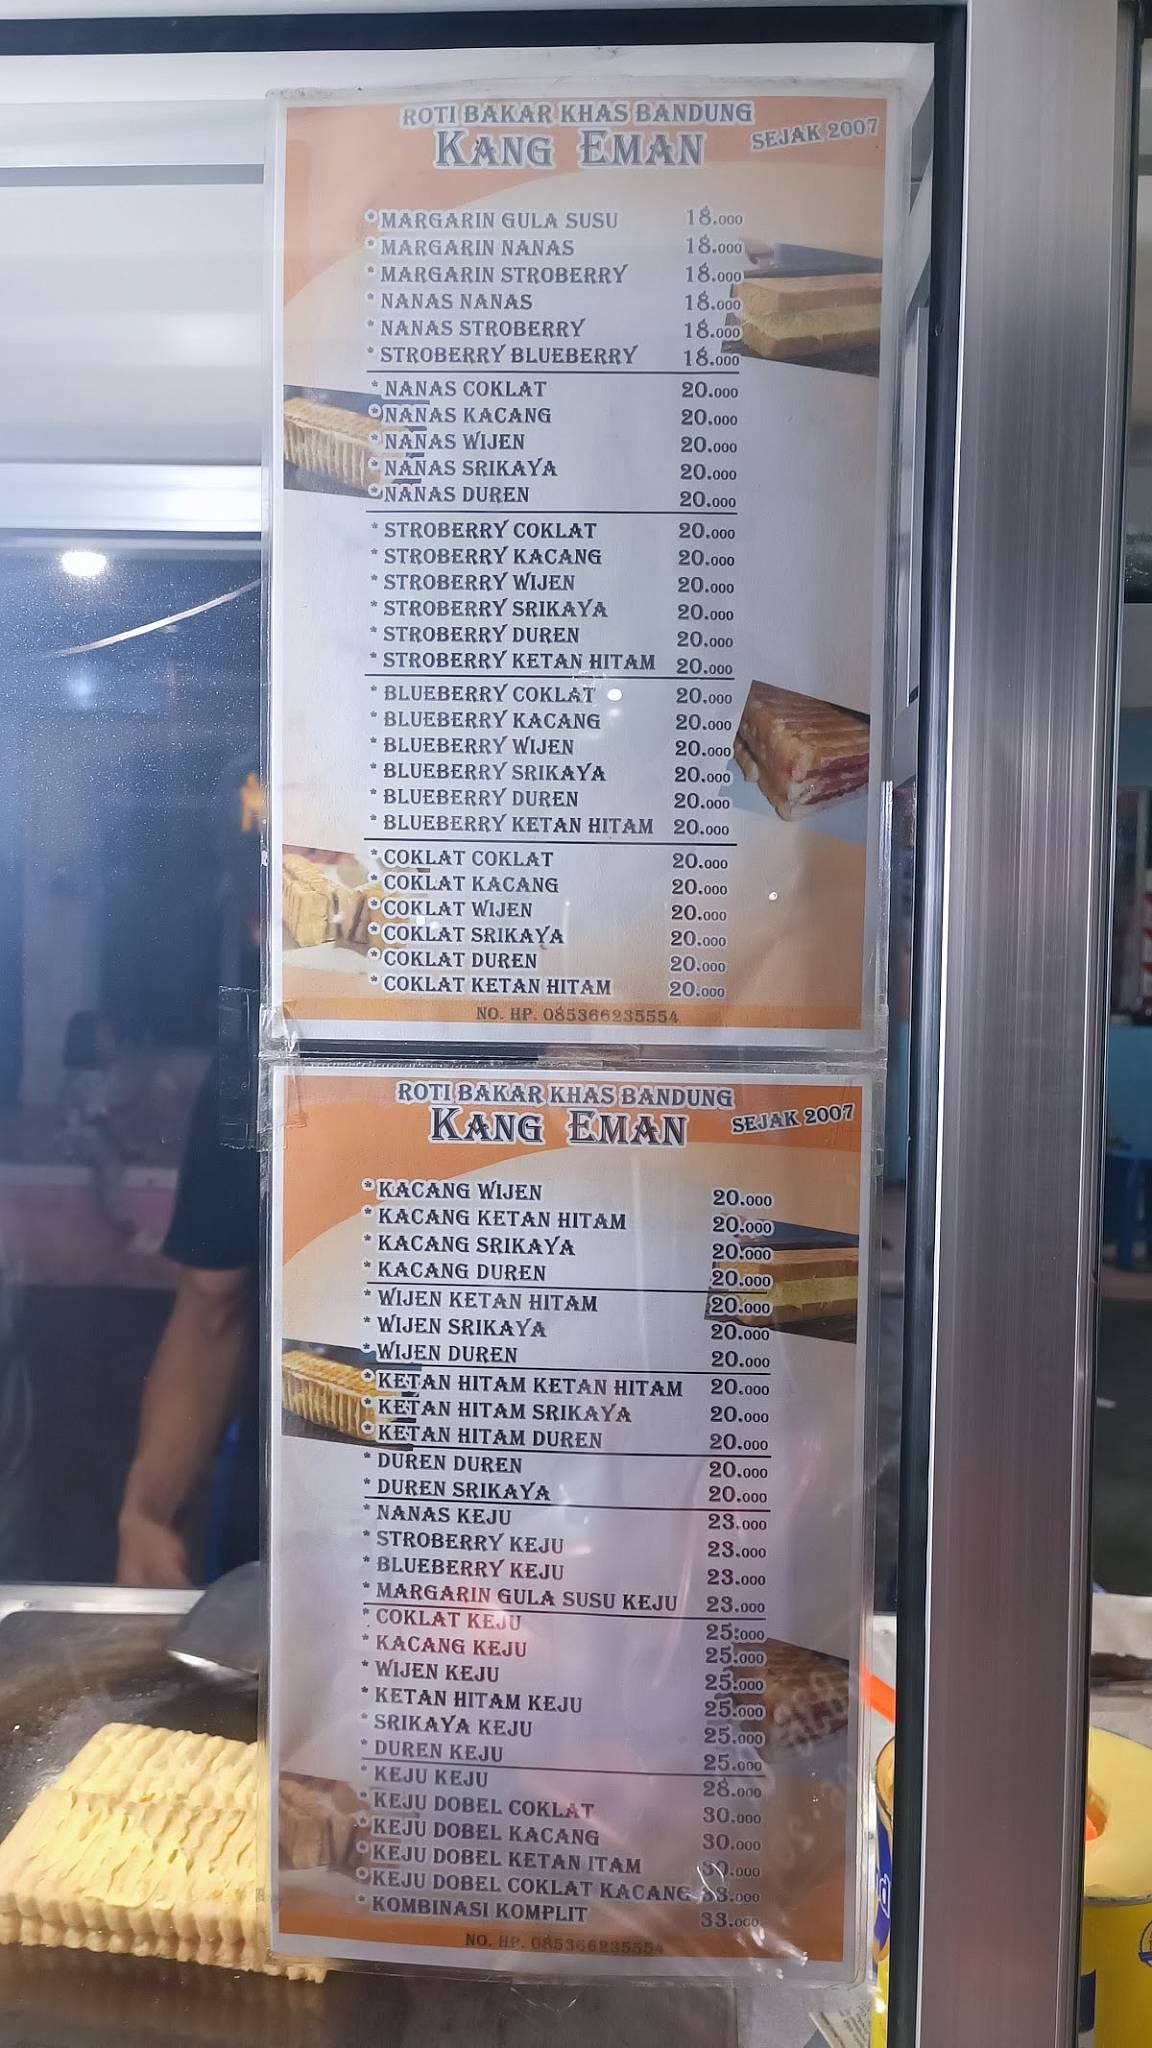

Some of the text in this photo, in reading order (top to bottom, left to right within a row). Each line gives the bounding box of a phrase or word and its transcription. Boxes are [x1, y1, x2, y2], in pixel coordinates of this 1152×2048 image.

[403, 103, 753, 126] ROTI BAKAR KHAS BANDUNG
[752, 118, 877, 149] SEJAK 2007
[382, 205, 743, 229] MARGARIN GULA SUSU 18.000
[381, 262, 741, 284] MARGARIN STROBERRY 18.000
[382, 290, 740, 311] NANAS NANAS 18.000
[381, 344, 739, 366] STROBERRY BLUEBERRY 18.000
[386, 380, 738, 398] NANAS COKLAT 20.000
[386, 431, 737, 453] NANAS WIJEN 20.000
[385, 458, 736, 480] NANAS SRIKAYA 20.000
[385, 519, 735, 539] STROBERRY COKLAT 20.000
[384, 572, 734, 593] STROBERRY WIJEN 20.000
[384, 624, 733, 647] STROBERRY DUREN 20.000
[384, 650, 732, 674] STROBERRY KETAN HITAM 20.000
[384, 710, 732, 730] BLUEBERRY KACANG 20.000
[384, 762, 730, 783] BLUEBERRY SRIKAYA 20.000
[384, 814, 729, 835] BLUEBERRY KETAN HITAM 20.000
[384, 849, 728, 869] COKLAT COKLAT 20.000
[384, 900, 726, 921] COKLAT WIJEN 20.000
[384, 926, 726, 946] COKLAT SRIKAYA 20.000
[384, 976, 724, 997] COKLAT KETAN HITAM 20.000
[543, 1005, 679, 1024] 085366235554
[397, 1082, 733, 1107] ROTI BAKAR KHAS BANDUNG
[732, 1104, 853, 1132] SEJAK 2007
[379, 1180, 772, 1206] KACANG WIJEN 20.000
[379, 1208, 771, 1233] KACANG KETAN HITAM 20.000
[378, 1262, 772, 1286] KACANG DUREN 20.000
[377, 1314, 769, 1340] WIJEN SRIKAYA 20.000
[377, 1340, 770, 1368] WIJEN DUREN 20.000
[378, 1372, 769, 1396] KETAN HITAM KETAN HITAM 20.000
[379, 1425, 768, 1450] KETAN HITAM DUREN 20.000
[378, 1453, 768, 1478] DUREN DUREN 20.000
[377, 1505, 766, 1530] NANAS KEJU 23.000
[378, 1556, 766, 1585] BLUEBERRY KEJU 23.000
[376, 1582, 765, 1613] MARGARIN GULA SUSU KEJU 23.000
[376, 1608, 522, 1630] COKLAT KEJU
[375, 1658, 499, 1682] WIJEN KEJU
[376, 1687, 446, 1706] KETAN
[454, 1691, 520, 1710] HITAM
[528, 1695, 582, 1713] KEJU
[375, 1714, 470, 1734] SRIKAYA
[479, 1720, 532, 1737] KEJU
[376, 1740, 442, 1758] DUREN
[450, 1744, 502, 1762] KEJU
[375, 1766, 428, 1784] KEJU
[435, 1769, 488, 1787] KEJU
[374, 1792, 426, 1810] KEJU
[434, 1796, 502, 1814] DOBEL
[509, 1800, 594, 1818] COKLAT
[374, 1818, 426, 1837] KEJU
[434, 1822, 502, 1840] DOBEL
[510, 1826, 599, 1846] KACANG
[374, 1844, 640, 1874] KEJU DOBEL KETAN ITAM
[373, 1870, 593, 1896] KEJU DOBEL COKLAT
[373, 1896, 588, 1922] KOMBINASI KOMPLIT
